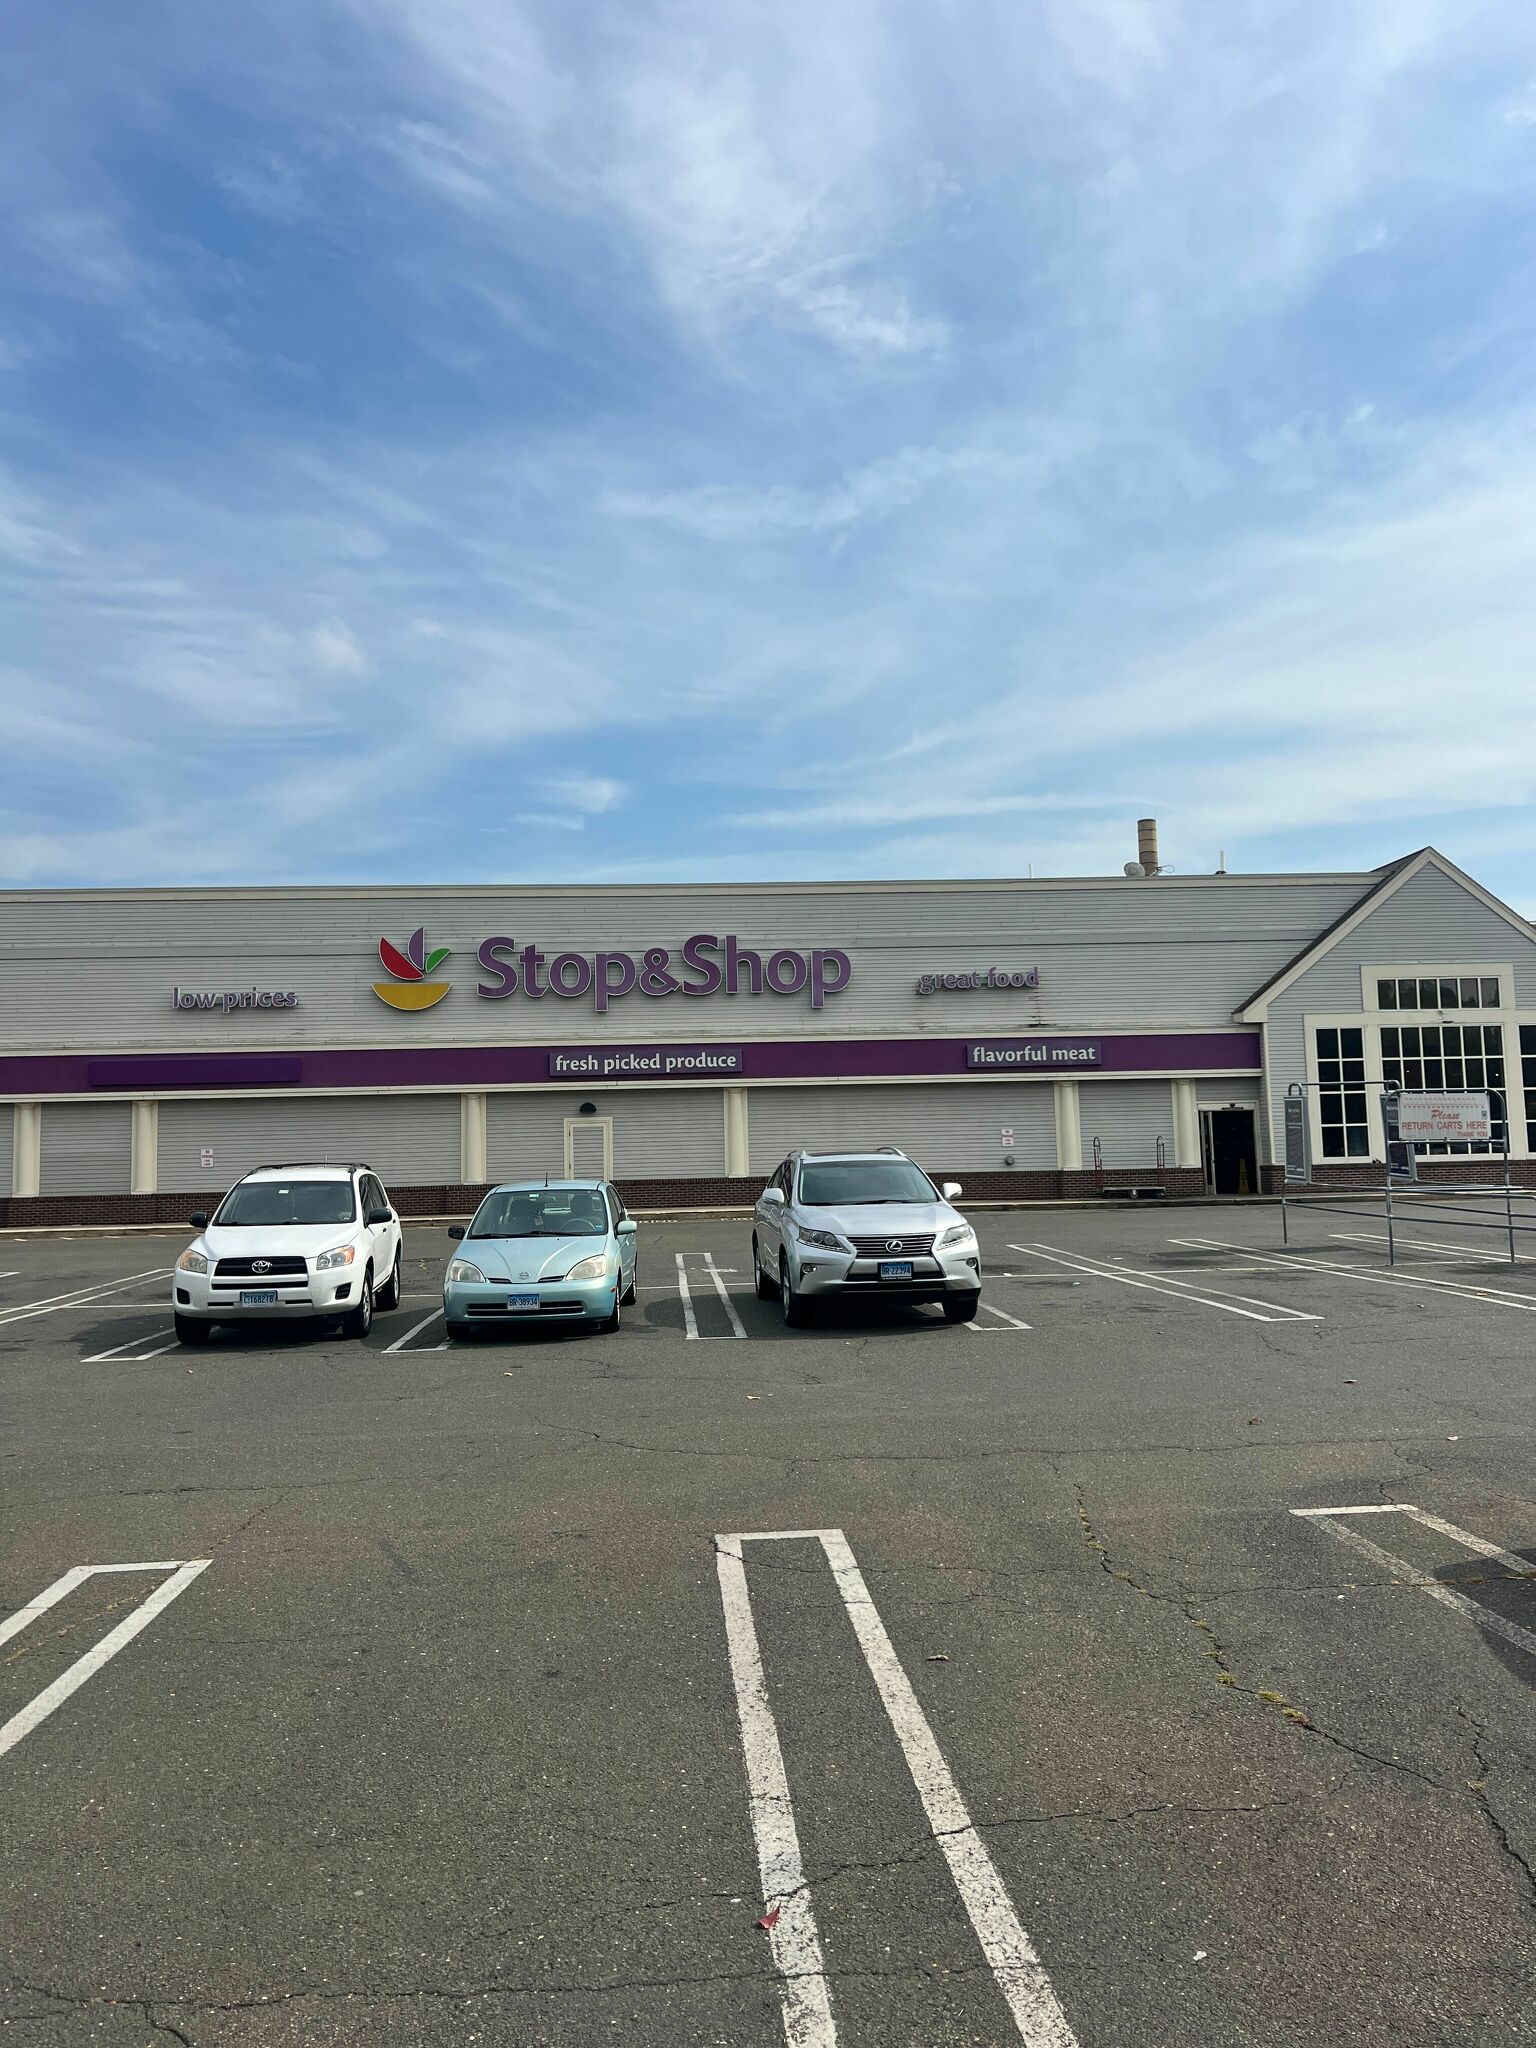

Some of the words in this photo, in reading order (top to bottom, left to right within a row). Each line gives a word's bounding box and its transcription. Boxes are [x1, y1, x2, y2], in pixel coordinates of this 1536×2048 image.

[477, 934, 852, 1013] Stop&Shop
[920, 971, 980, 995] great
[987, 966, 1040, 988] food
[172, 986, 216, 1009] low
[222, 986, 298, 1014] prices
[555, 1055, 599, 1071] fresh
[603, 1053, 661, 1074] picked
[665, 1052, 737, 1072] produce
[972, 1045, 1047, 1062] flavorful
[1052, 1047, 1096, 1061] meat
[1402, 1121, 1433, 1130] RETURN
[1437, 1121, 1462, 1130] CARTS
[1466, 1121, 1487, 1129] HERE
[1431, 1109, 1461, 1120] Please
